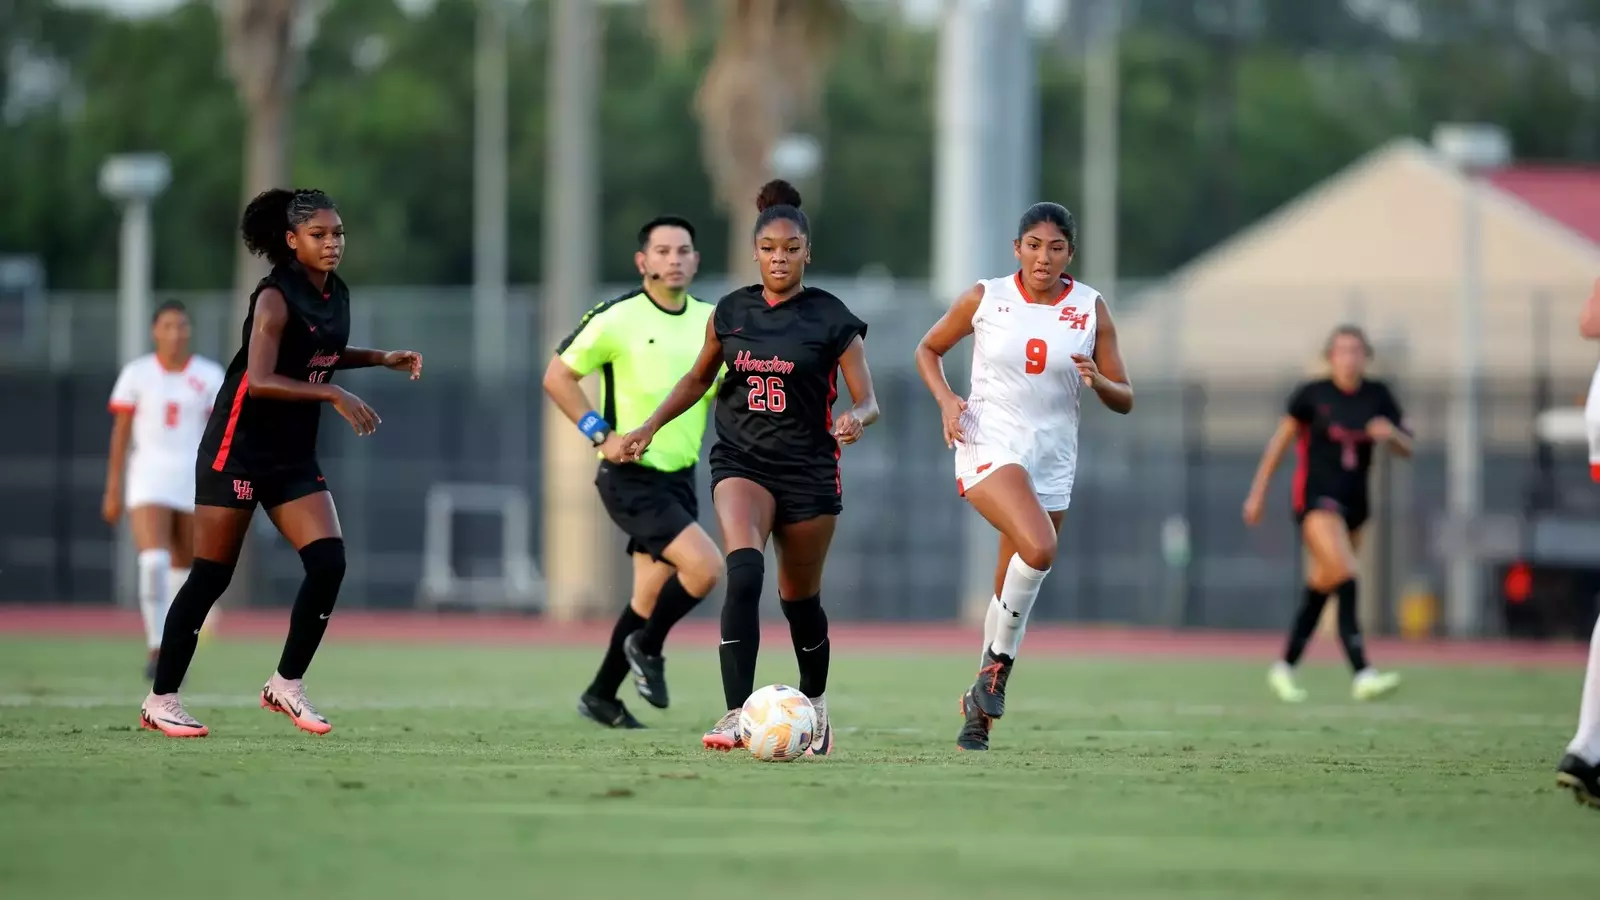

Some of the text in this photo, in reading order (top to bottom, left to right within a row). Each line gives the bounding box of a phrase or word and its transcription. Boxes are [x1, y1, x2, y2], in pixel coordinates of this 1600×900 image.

[734, 350, 794, 374] Houston
[1025, 338, 1048, 375] 9
[746, 376, 787, 412] 26
[233, 480, 253, 500] UH
